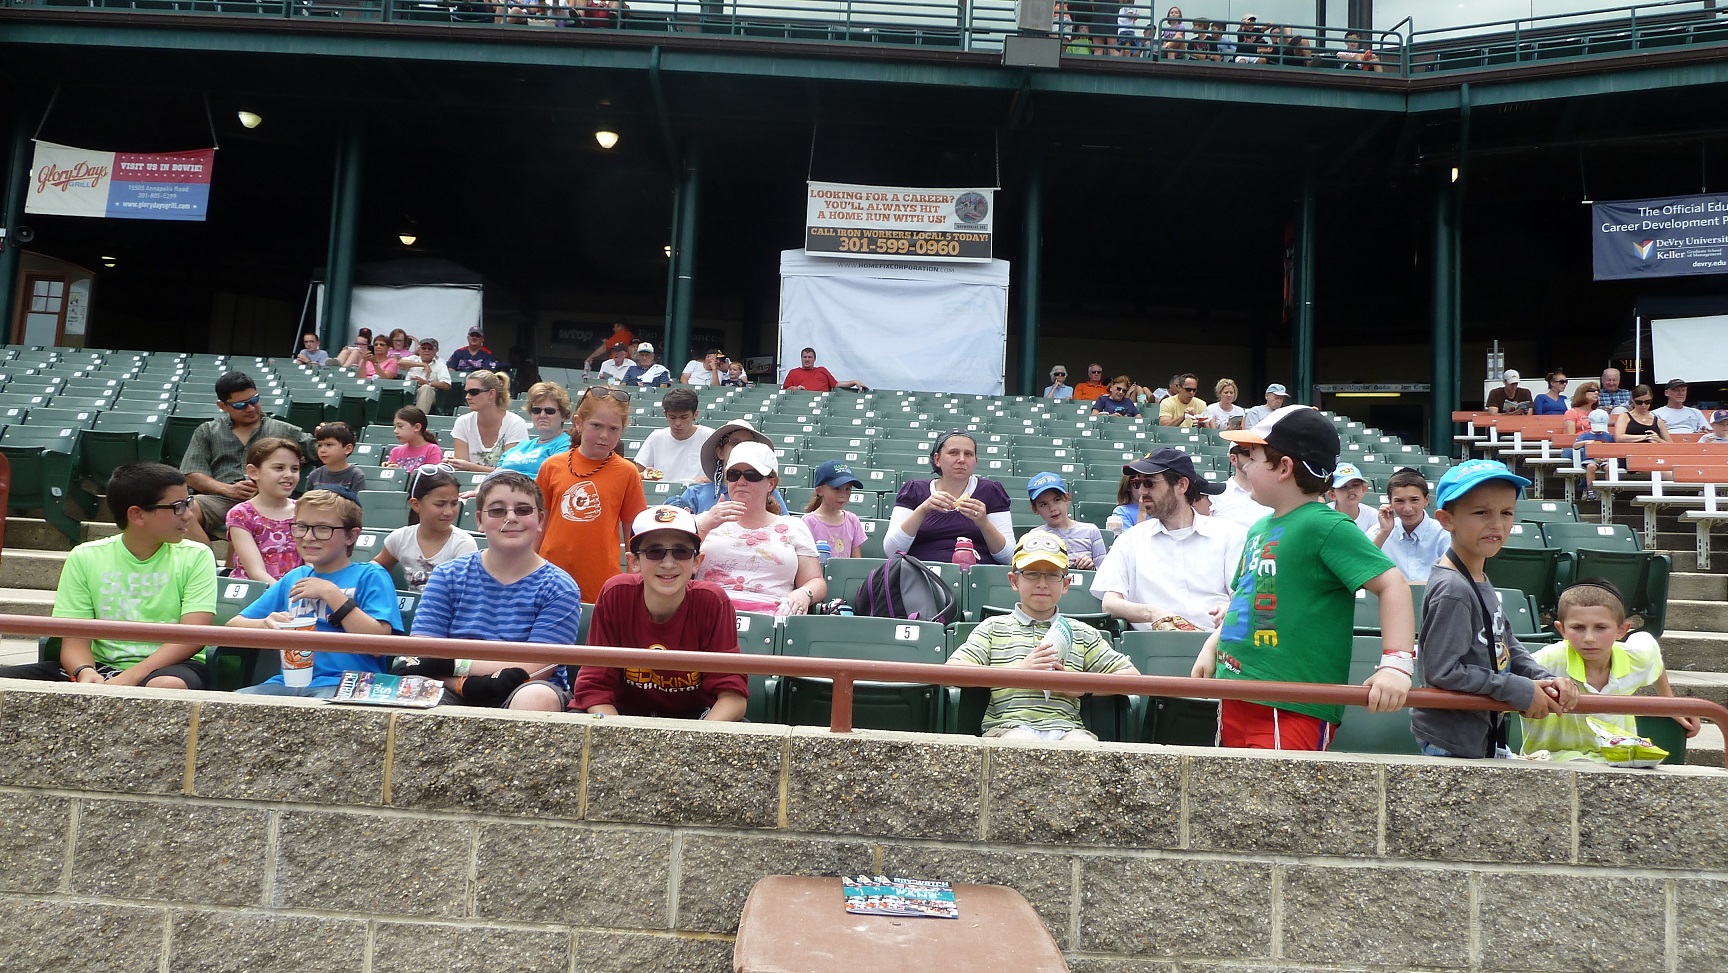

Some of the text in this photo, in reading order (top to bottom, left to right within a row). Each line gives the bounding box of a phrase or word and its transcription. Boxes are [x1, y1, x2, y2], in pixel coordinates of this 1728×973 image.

[120, 162, 203, 172] VISIT US IN BOWIE!
[37, 160, 108, 193] Glory Days
[810, 190, 955, 203] LOOKING FOR A CAREER?
[824, 200, 940, 213] YOU'LL ALWAYS HIT
[1638, 207, 1660, 217] The
[1663, 203, 1705, 215] Official
[817, 210, 947, 223] A HOME RUN WITH US!
[1601, 222, 1640, 233] Career
[1642, 217, 1720, 230] Development
[810, 227, 835, 236] CALL
[837, 228, 861, 237] IRON
[863, 230, 912, 239] WORKERS
[913, 232, 944, 240] LOCAL
[953, 233, 989, 242] TODAY!
[839, 237, 960, 256] 301-599-0960
[1656, 239, 1685, 248] DeVry
[1656, 251, 1686, 260] Keller
[837, 262, 955, 274] WWW.HOMEFIXCORPORATION.COM
[1692, 260, 1727, 268] devry.edu
[99, 571, 169, 597] SLEEP
[1253, 527, 1285, 648] AWESOME
[232, 585, 241, 597] 9
[98, 597, 142, 620] EAT
[398, 597, 407, 610] 8
[904, 626, 911, 639] 5
[624, 667, 702, 688] EDSKINS
